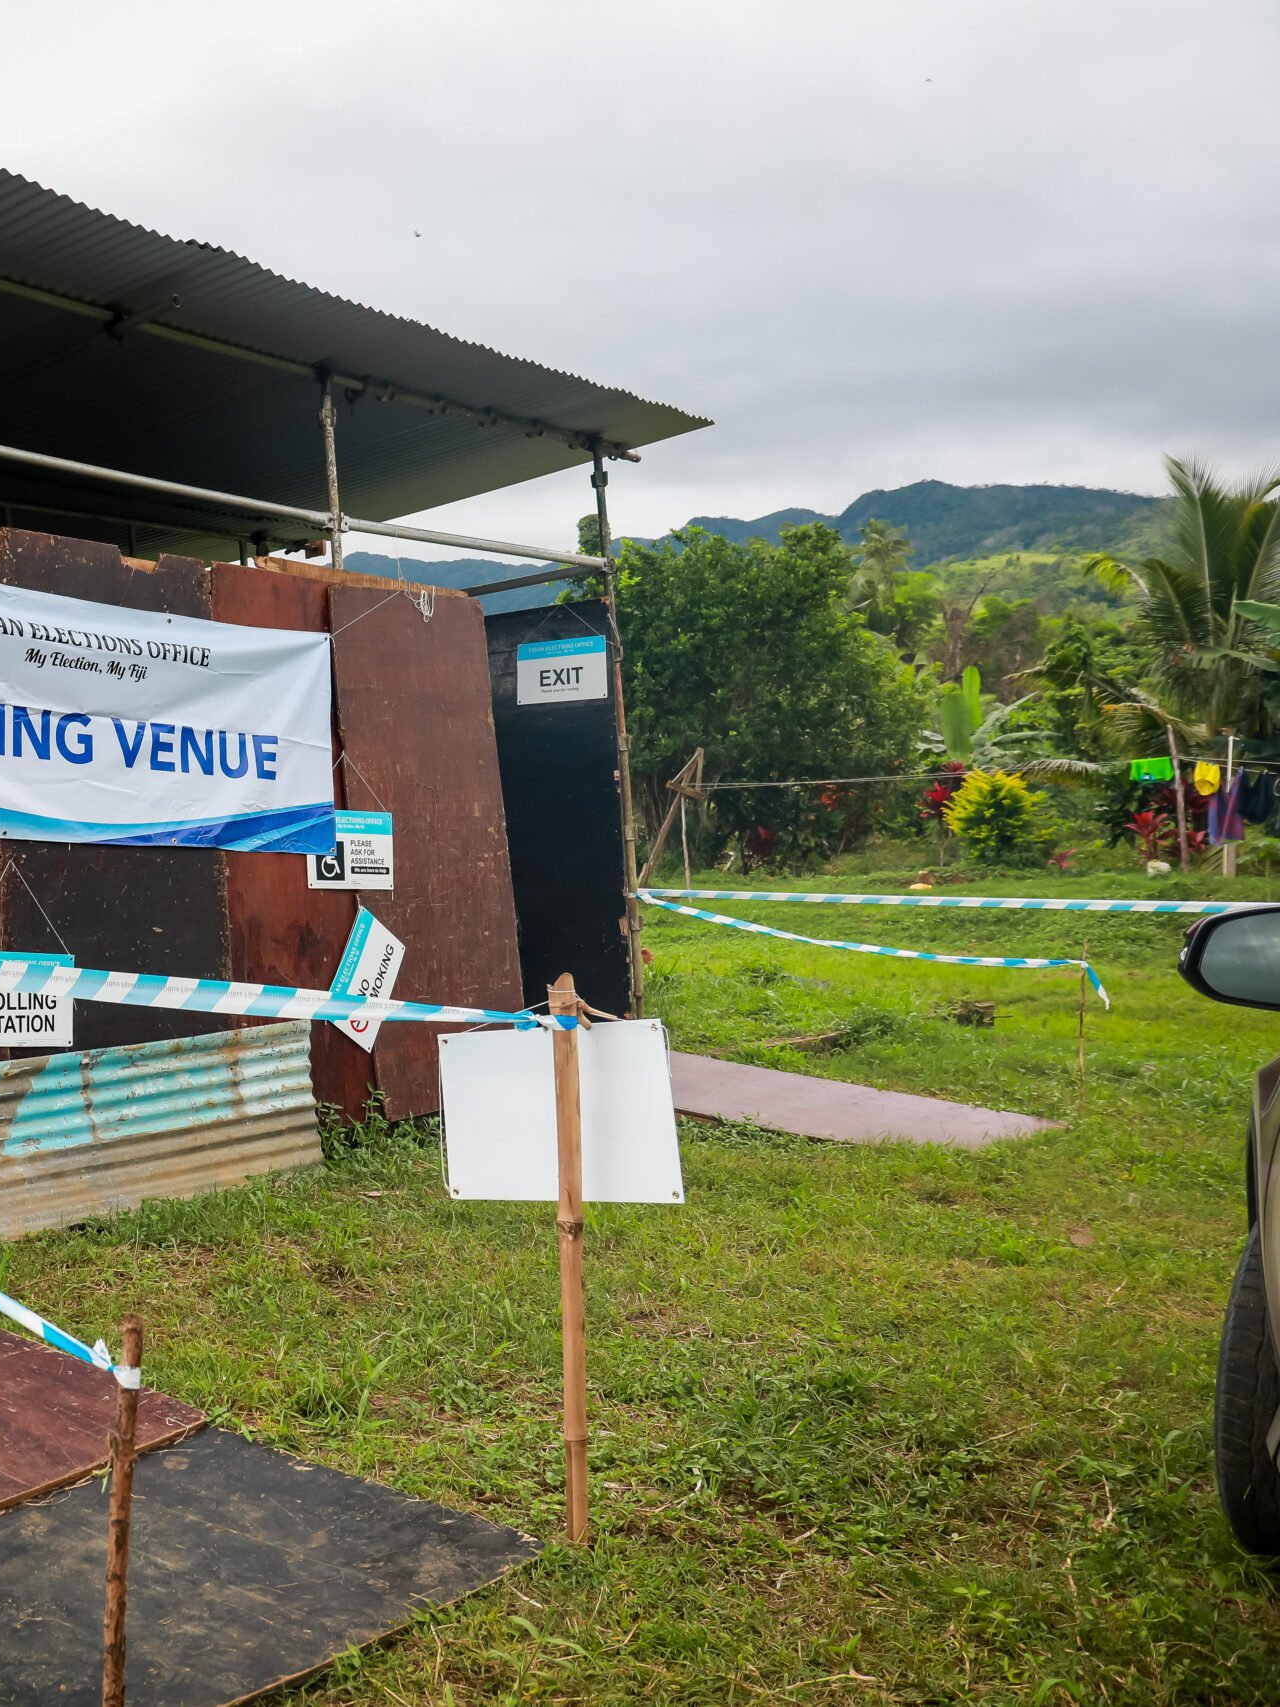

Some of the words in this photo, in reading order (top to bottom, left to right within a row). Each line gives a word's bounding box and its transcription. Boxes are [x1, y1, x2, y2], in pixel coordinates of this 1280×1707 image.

[28, 622, 143, 656] ELECTIONS
[146, 640, 211, 668] OFFICE
[24, 648, 47, 668] My
[50, 652, 102, 674] Election,
[106, 660, 127, 680] My
[128, 664, 148, 683] Fiji
[540, 667, 583, 687] EXIT
[109, 717, 279, 781] VENUE
[350, 857, 385, 865] ASSISTANCE
[370, 944, 394, 998] MOKING
